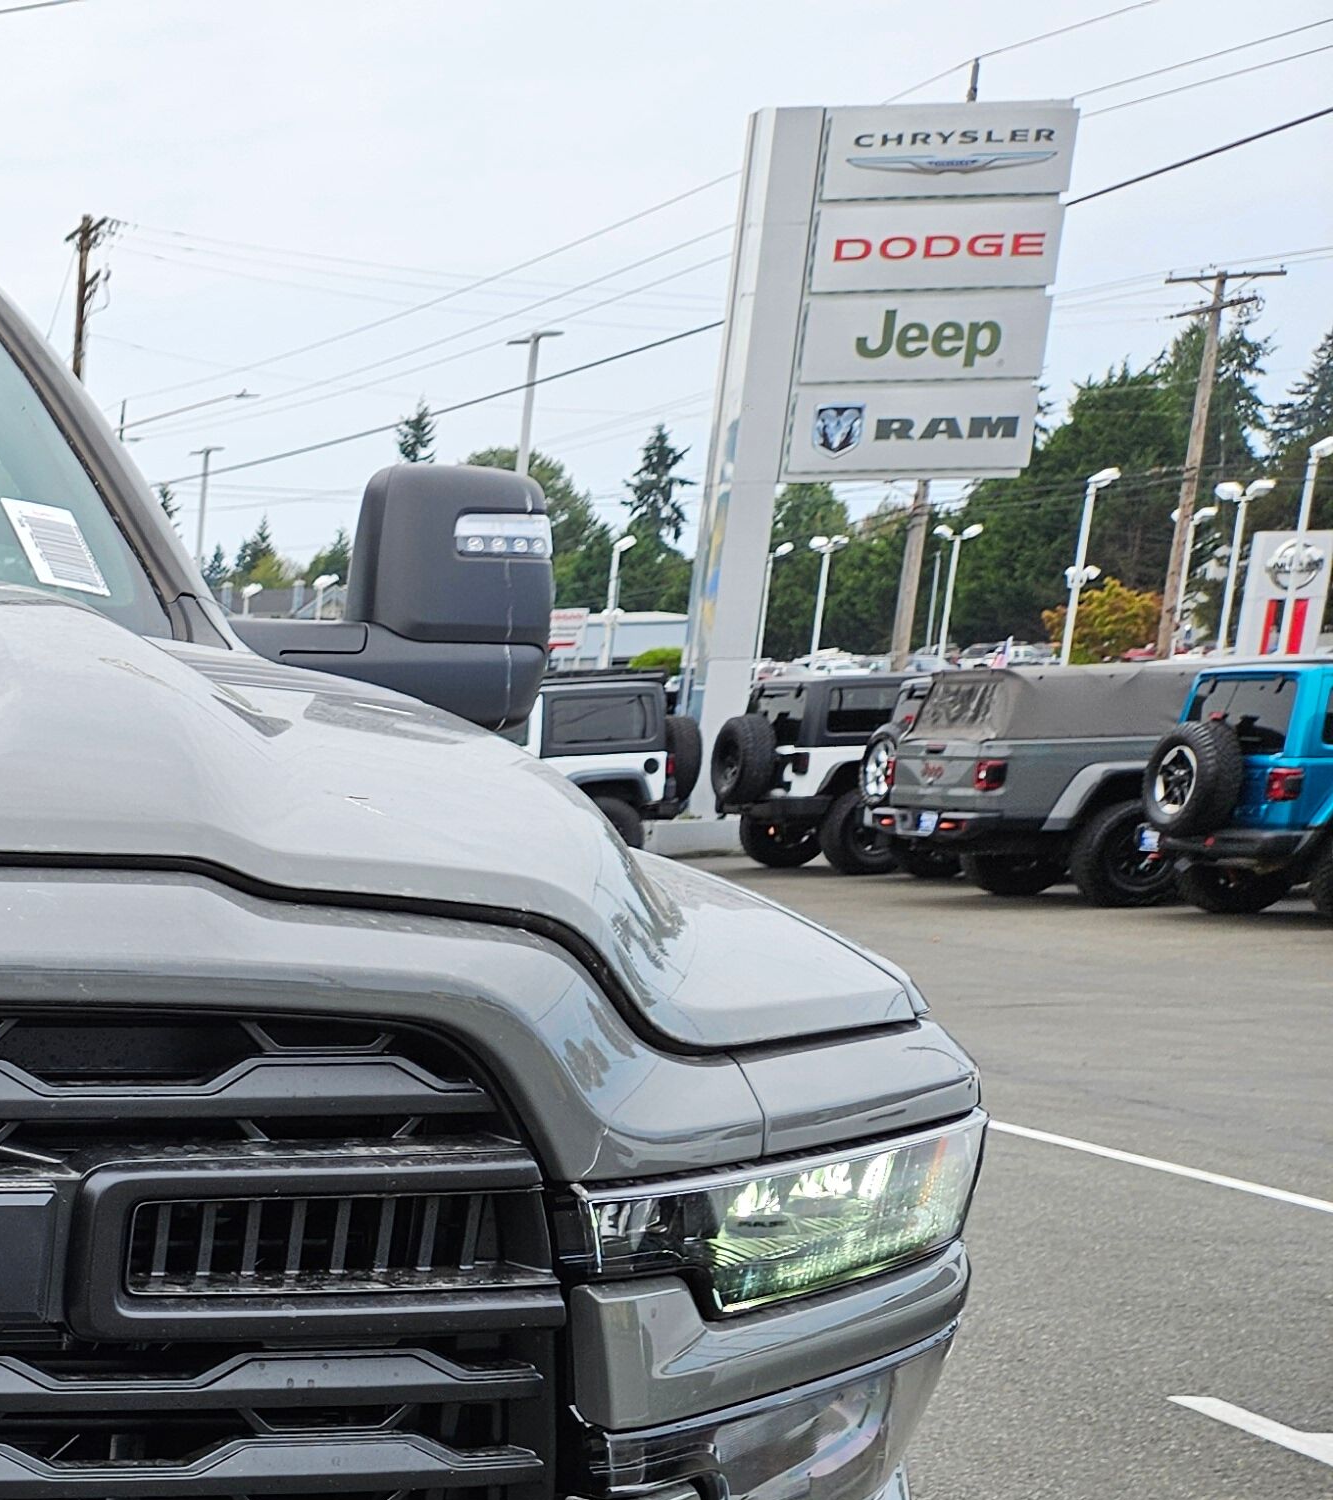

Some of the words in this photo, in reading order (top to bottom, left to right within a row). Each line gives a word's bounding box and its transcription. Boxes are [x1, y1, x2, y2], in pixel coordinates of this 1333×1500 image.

[854, 128, 1056, 148] CHRYSLER
[834, 232, 1046, 262] DODGE
[855, 309, 1002, 368] Jeep
[874, 415, 1020, 441] RAM
